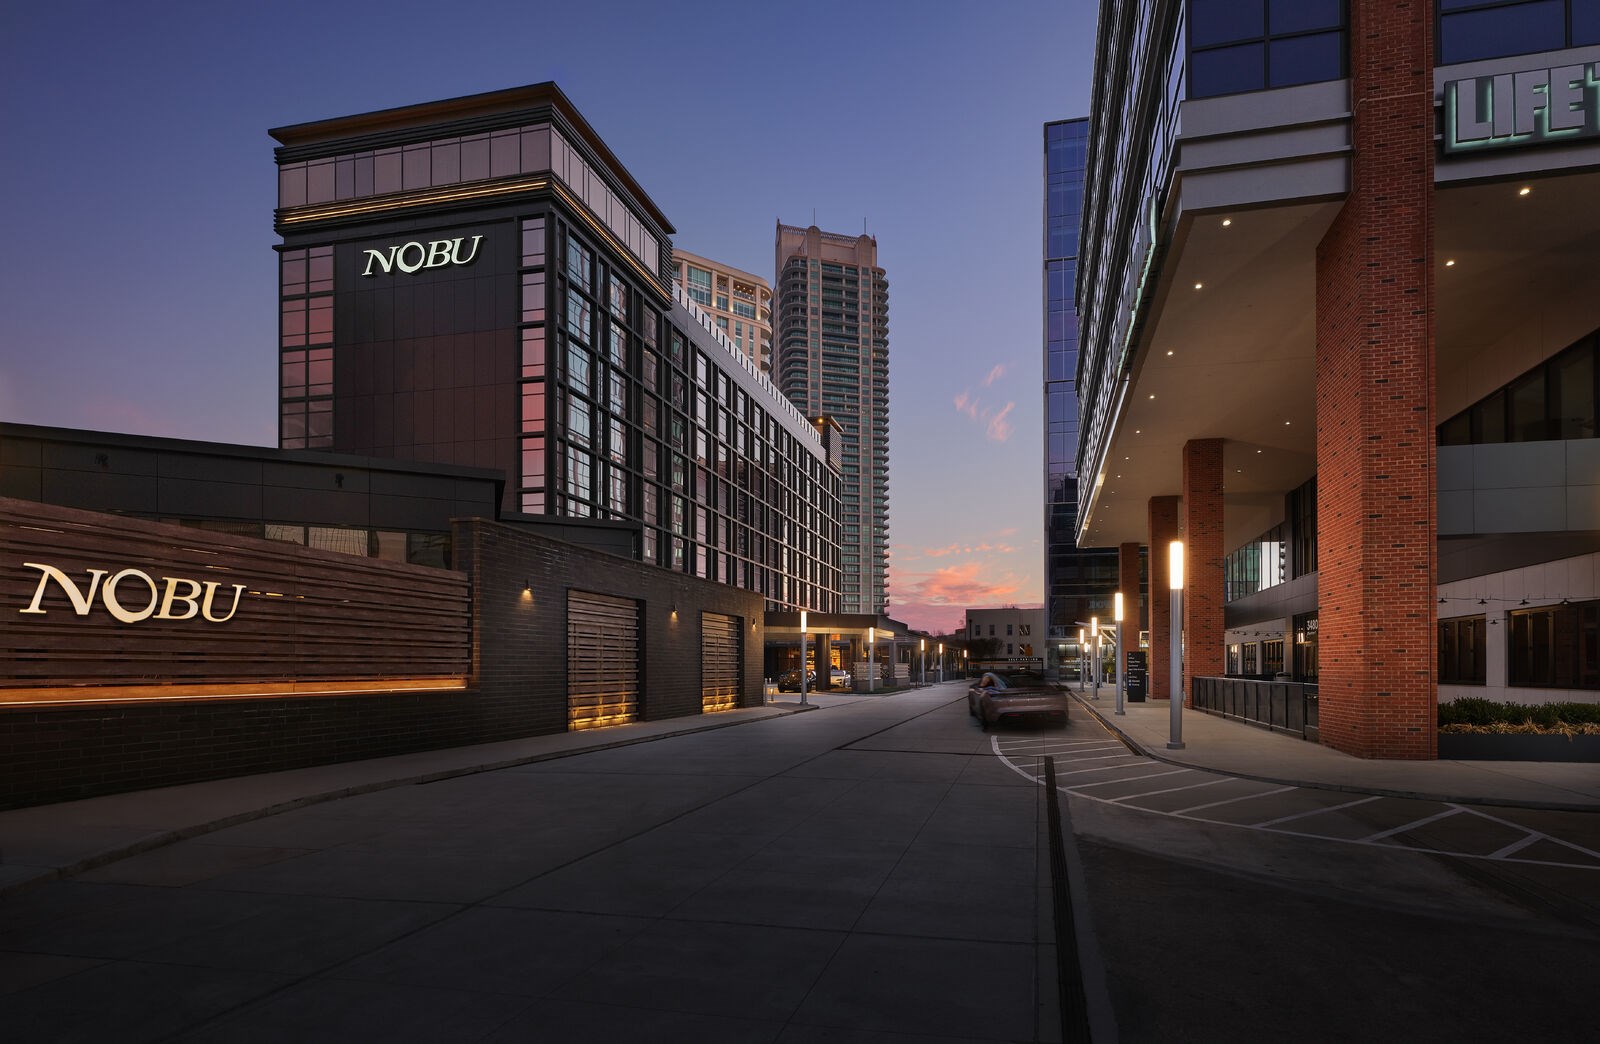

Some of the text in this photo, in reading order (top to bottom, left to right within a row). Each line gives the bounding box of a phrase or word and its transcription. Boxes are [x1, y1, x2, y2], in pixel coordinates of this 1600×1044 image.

[1457, 62, 1600, 141] LIFE
[362, 235, 484, 275] NOBU
[19, 562, 248, 624] NOBU
